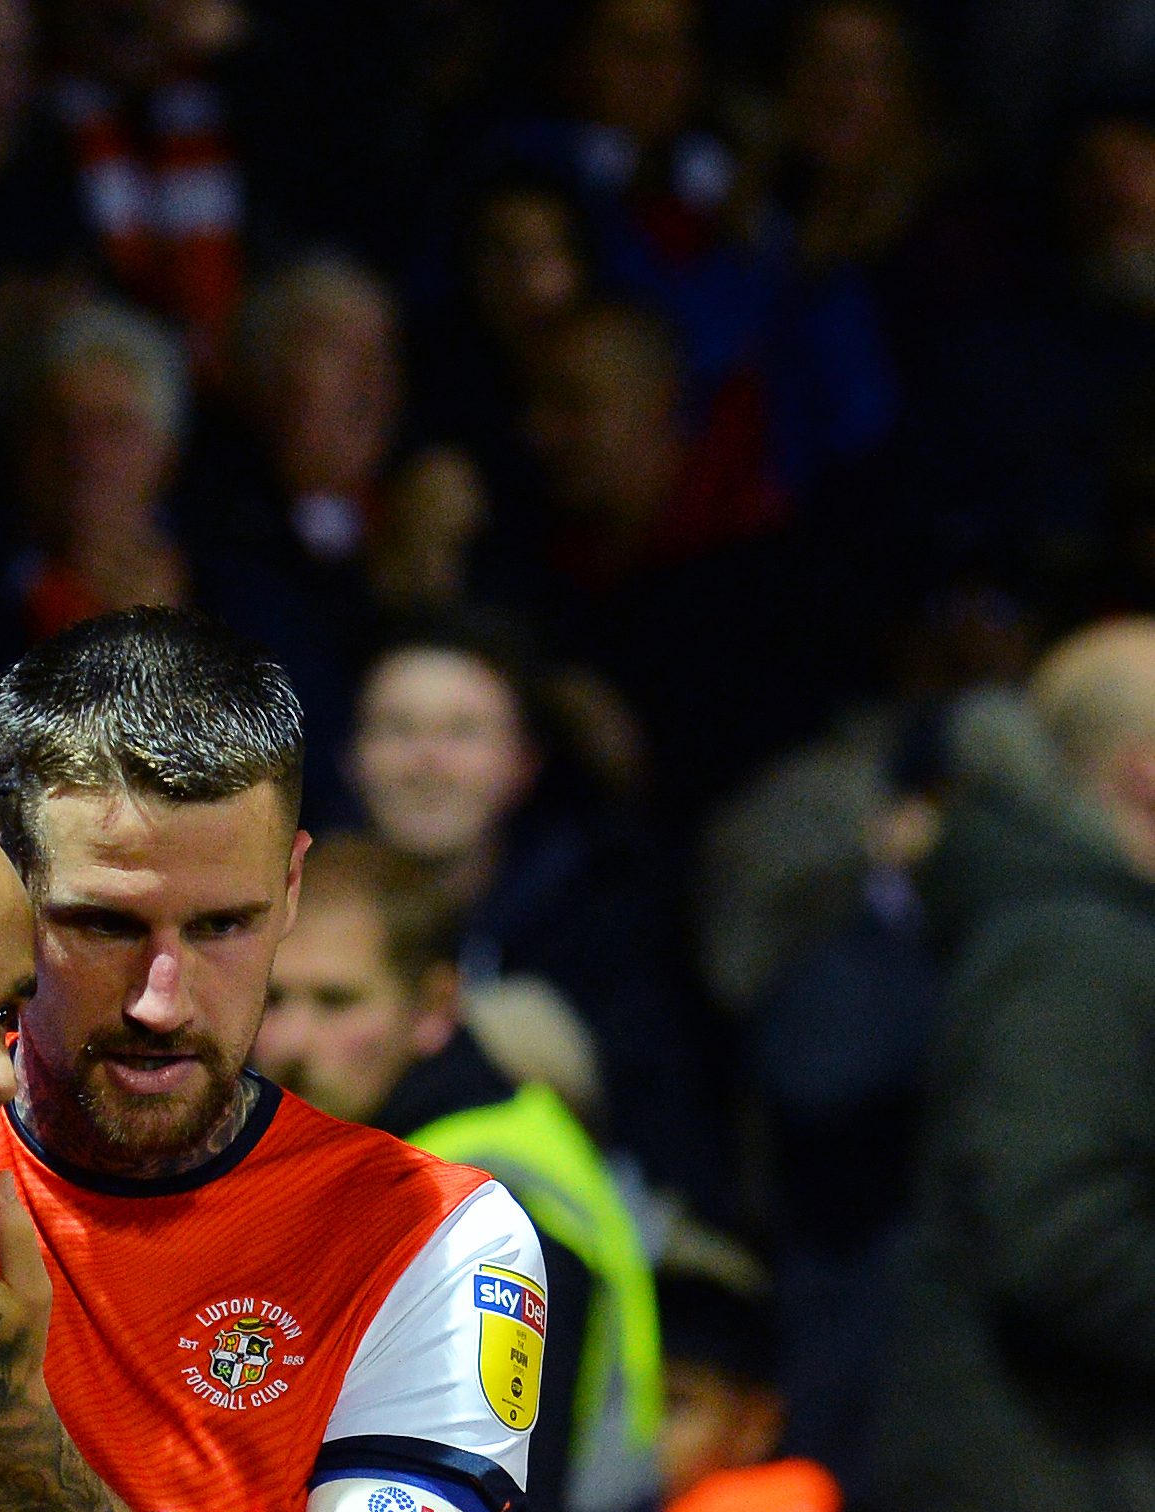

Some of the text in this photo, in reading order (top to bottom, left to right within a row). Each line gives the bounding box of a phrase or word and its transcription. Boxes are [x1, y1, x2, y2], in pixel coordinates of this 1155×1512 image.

[196, 1298, 303, 1340] LUTON TOWN
[479, 1280, 544, 1329] sky bet
[178, 1337, 199, 1350] EST
[181, 1366, 289, 1410] FOOTBALL CLUB
